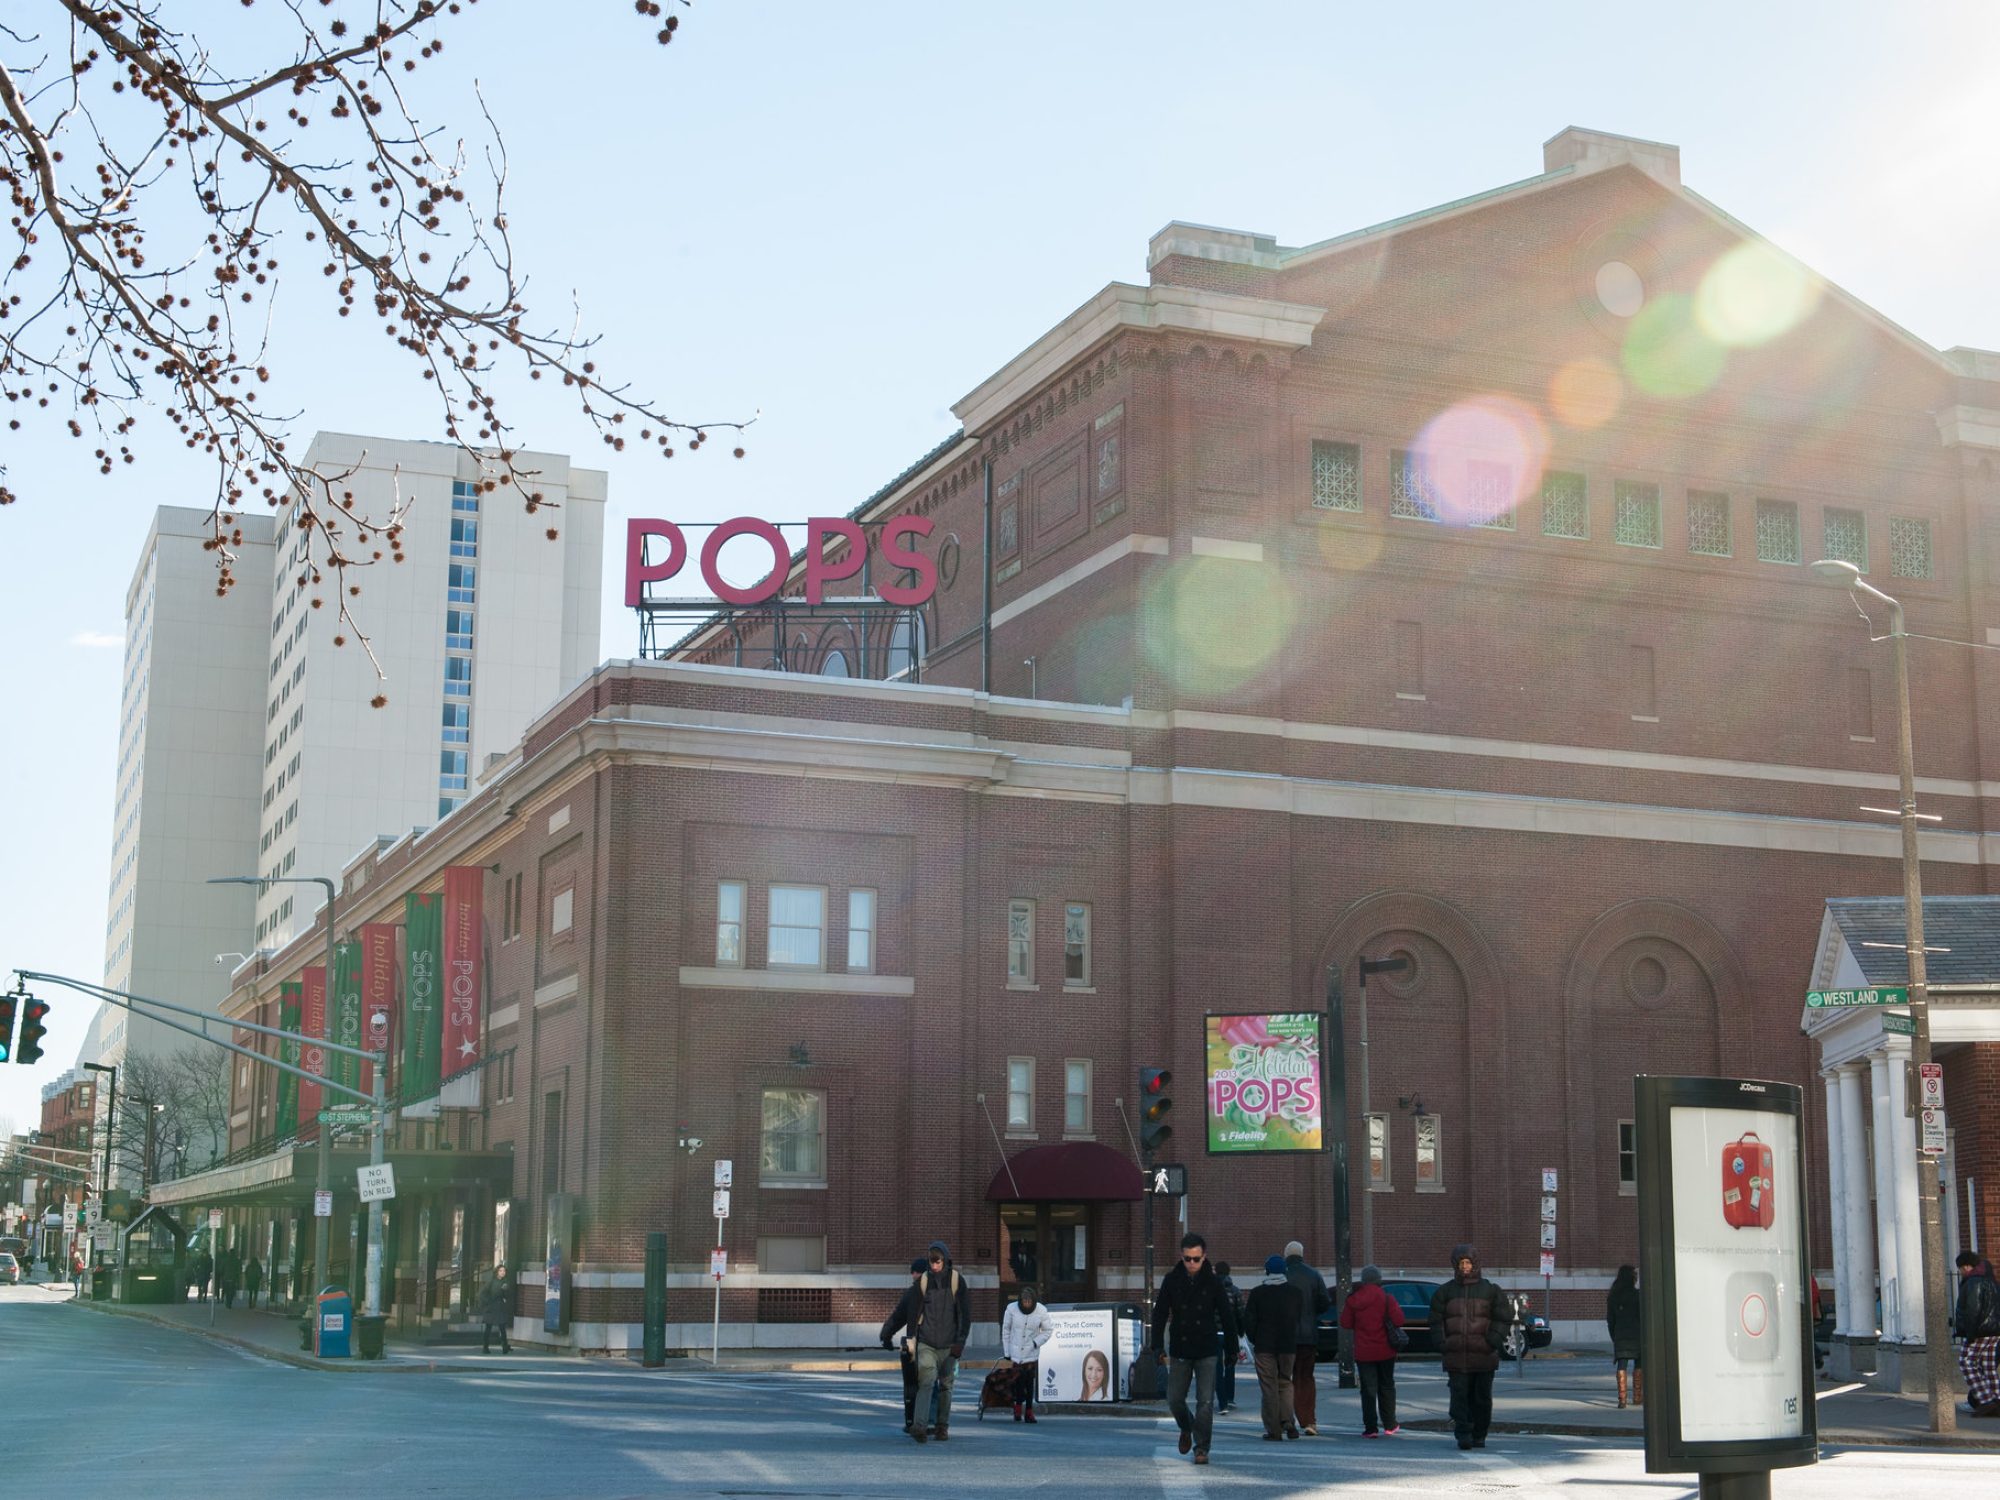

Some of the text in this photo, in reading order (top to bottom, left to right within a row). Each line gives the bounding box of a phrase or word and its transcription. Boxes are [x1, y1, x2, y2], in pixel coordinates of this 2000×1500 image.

[624, 515, 938, 606] POPS
[370, 934, 389, 1002] holiday
[412, 950, 432, 1011] POPS
[452, 902, 472, 1026] holiday POPS
[340, 993, 358, 1046] POPS
[1823, 990, 1897, 1006] WESTLAND AVE
[1215, 1078, 1315, 1114] POPS
[1228, 1132, 1267, 1140] Fidelity
[366, 1178, 386, 1187] TURN
[91, 1211, 98, 1220] 9
